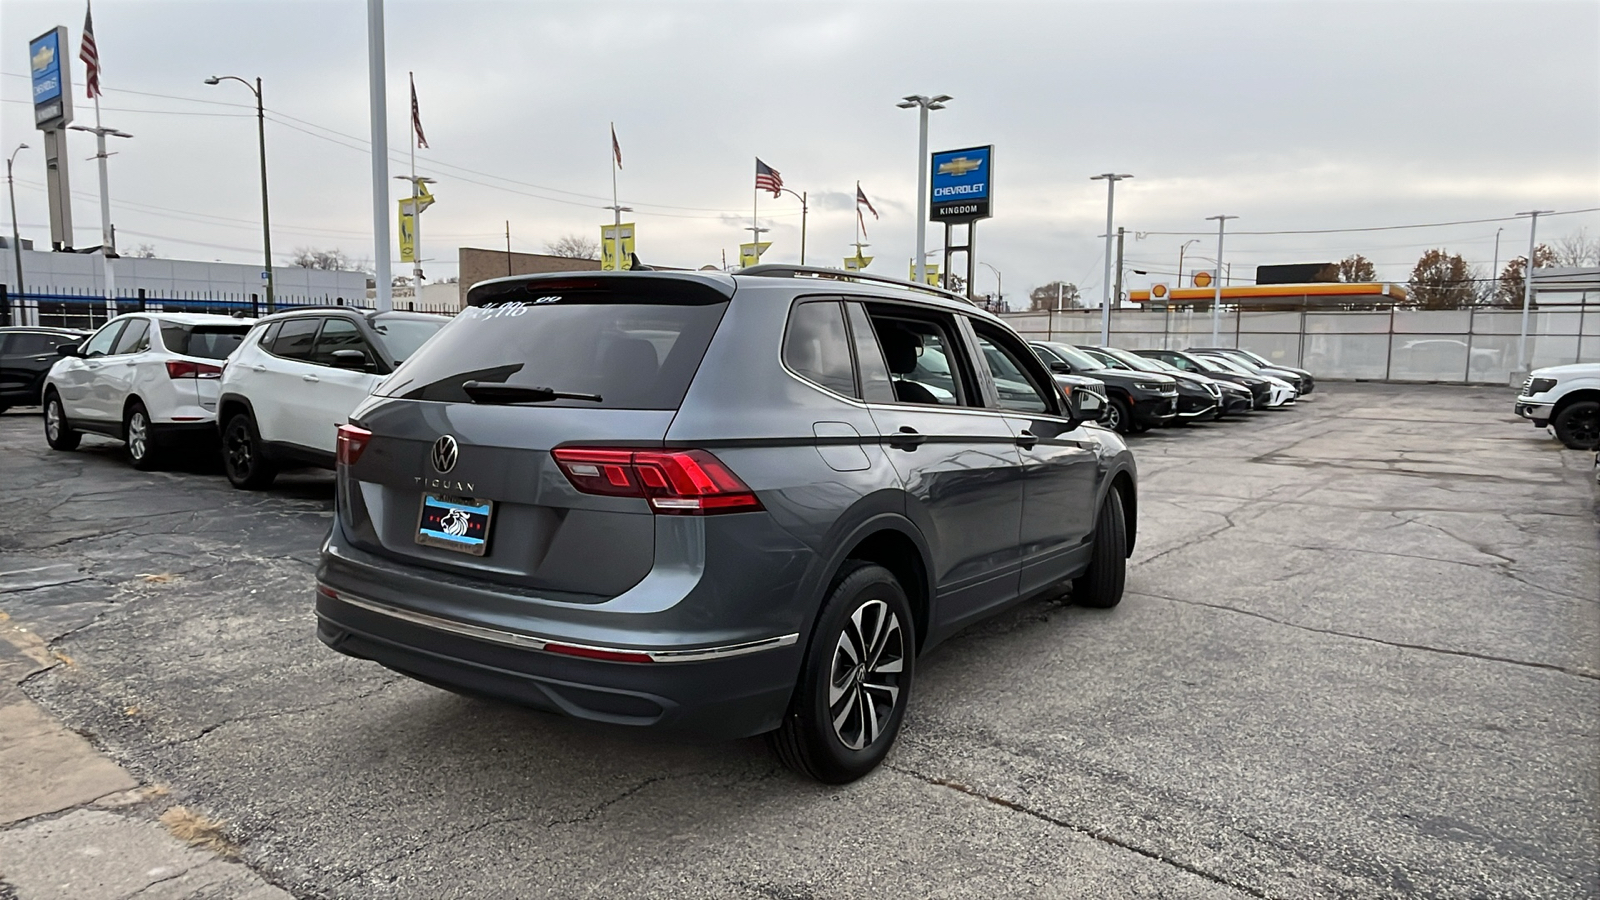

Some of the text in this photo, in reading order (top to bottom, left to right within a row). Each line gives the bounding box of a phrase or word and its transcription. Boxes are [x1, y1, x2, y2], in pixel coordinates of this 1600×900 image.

[934, 183, 984, 197] CHEVROLET
[940, 205, 978, 215] KINGDOM
[414, 476, 475, 492] TIGUAN
